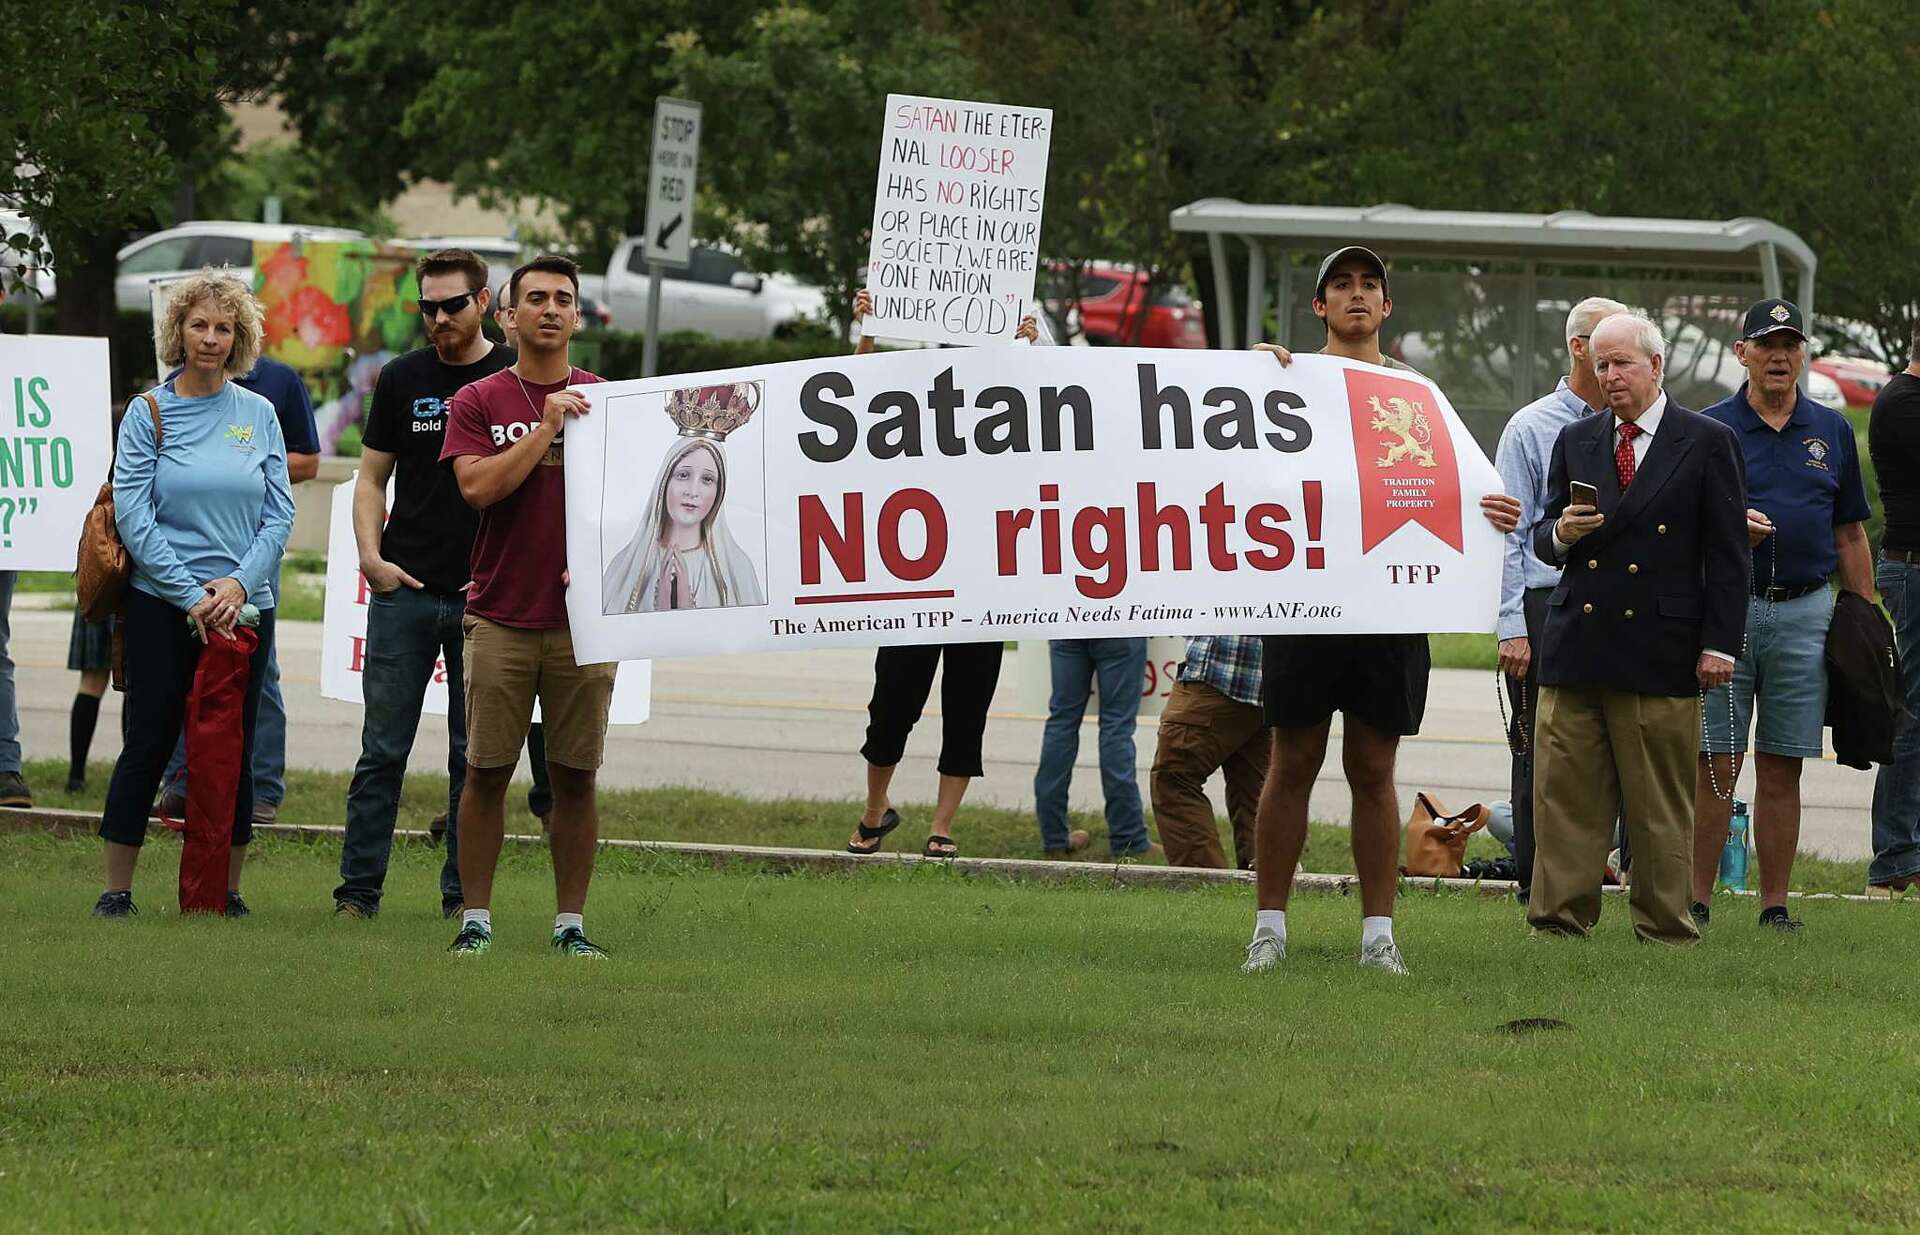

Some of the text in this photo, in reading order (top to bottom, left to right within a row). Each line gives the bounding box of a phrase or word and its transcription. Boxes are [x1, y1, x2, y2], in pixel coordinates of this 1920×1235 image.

[661, 115, 696, 143] STOP
[895, 104, 1047, 139] SATAN THE ETER-
[892, 137, 1015, 176] NAL LOOSER
[659, 175, 687, 202] RED
[886, 173, 1041, 213] HAS NO RIGHTS
[880, 210, 1036, 246] OR PLACE IN OUR
[968, 246, 992, 269] WE
[929, 267, 991, 296] NATION
[874, 294, 937, 323] UNDER
[14, 376, 51, 428] IS
[797, 363, 1314, 464] Satan has
[412, 420, 442, 433] Bold
[0, 436, 74, 488] NTO
[1382, 477, 1436, 487] TRADITION
[1391, 488, 1428, 497] FAMILY
[1385, 499, 1436, 509] PROPERTY
[798, 480, 1326, 599] NO rights!
[1386, 564, 1442, 585] TFP
[769, 618, 807, 636] The
[813, 614, 906, 634] American
[912, 610, 955, 629] TFP
[979, 607, 1060, 628] America
[1065, 604, 1122, 623] Needs
[1127, 603, 1194, 622] Fatima
